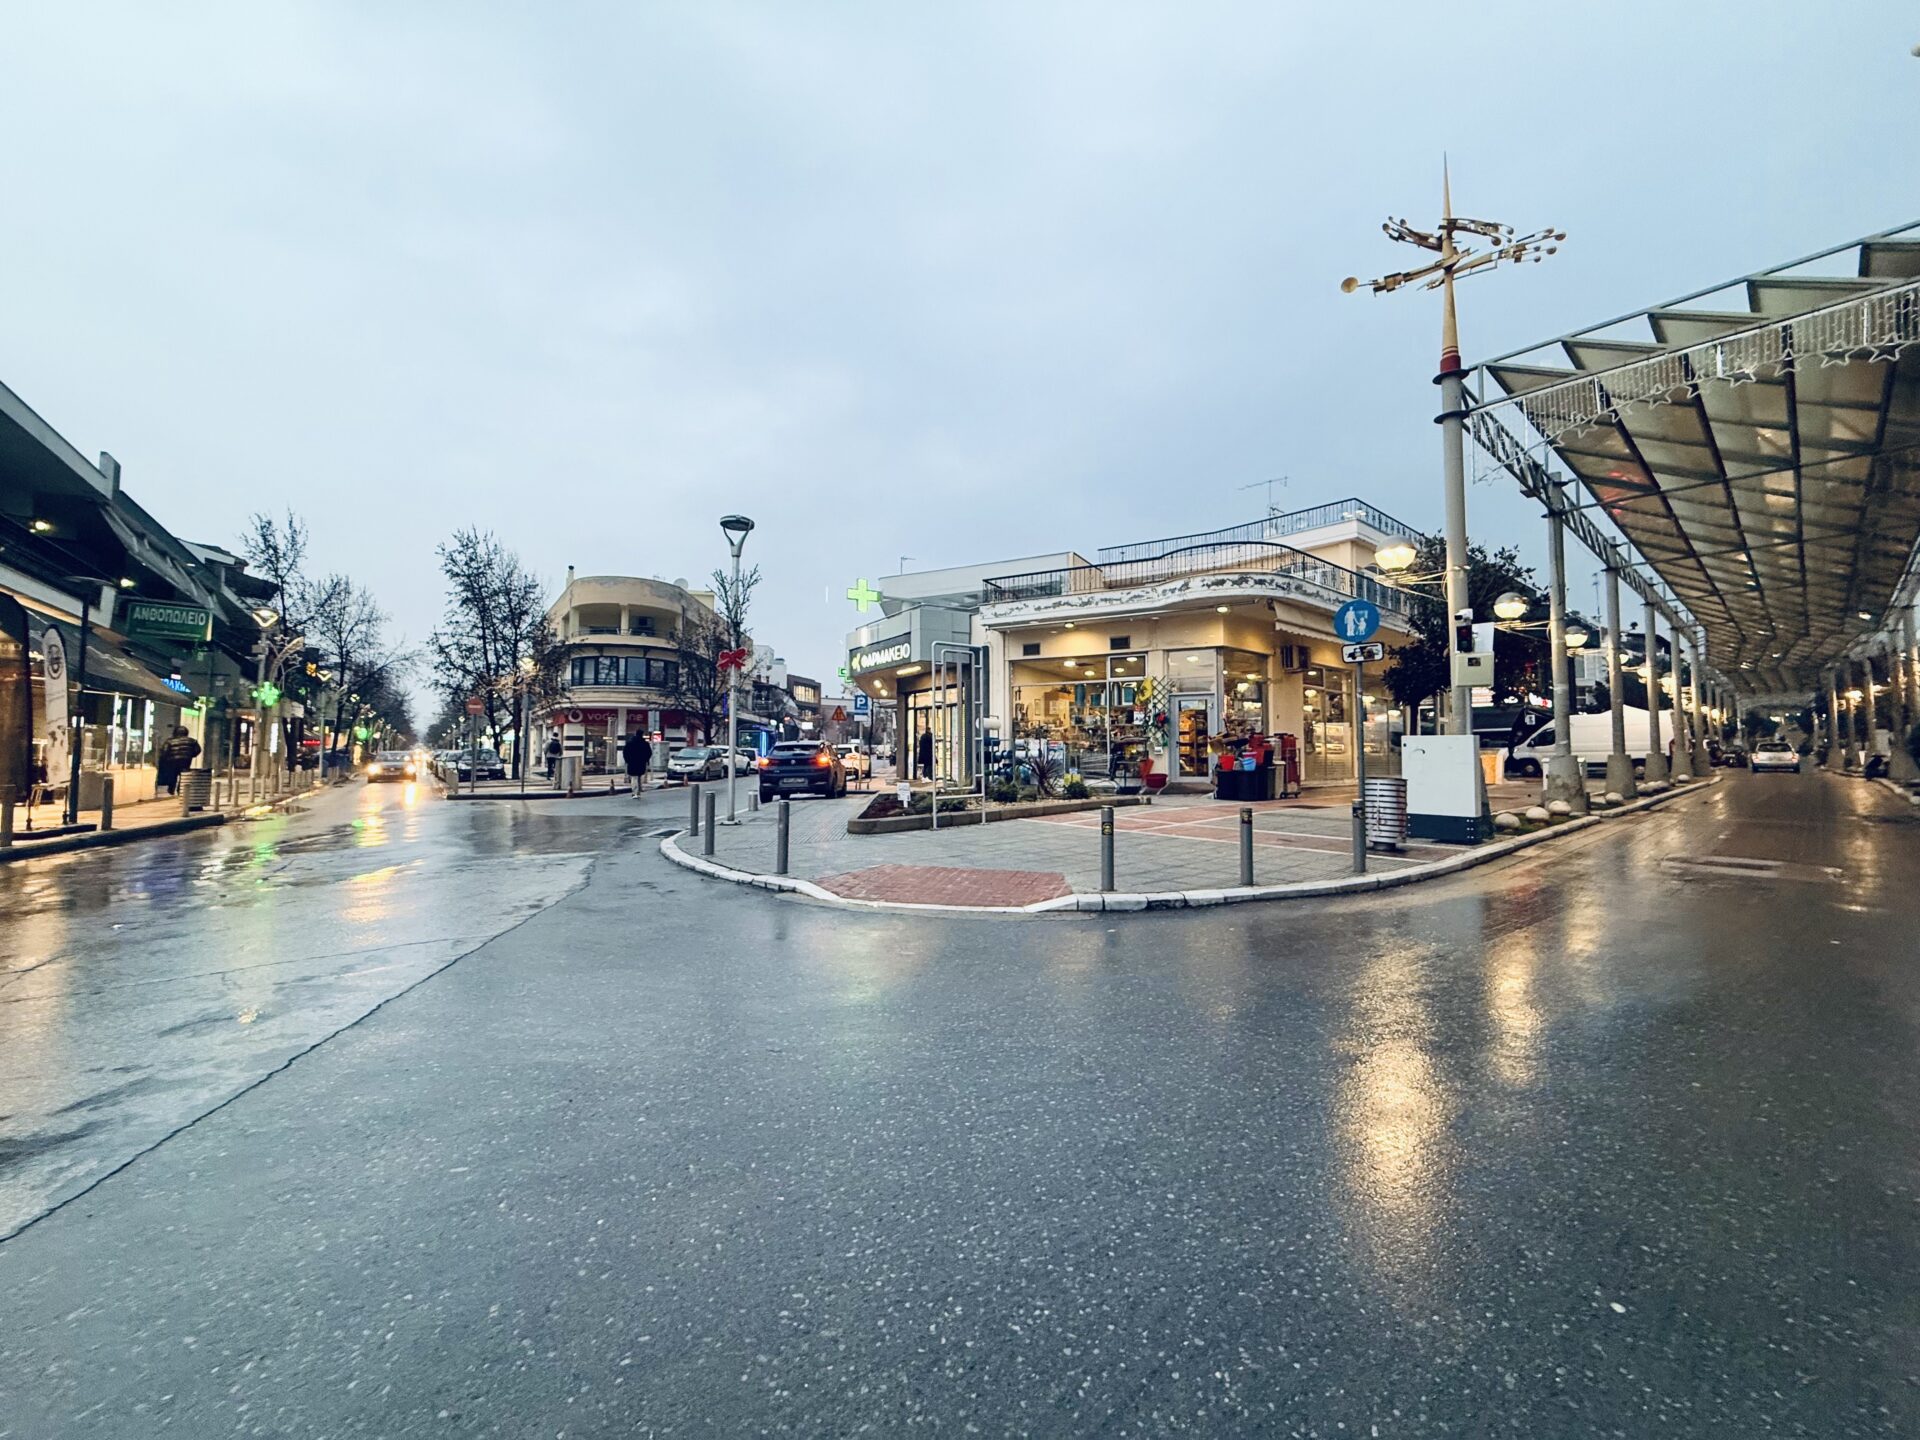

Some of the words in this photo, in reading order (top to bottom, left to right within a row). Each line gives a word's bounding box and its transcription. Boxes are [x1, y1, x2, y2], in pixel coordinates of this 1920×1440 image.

[133, 606, 206, 626] ΑΝΘΟΠΩΛΕΙΟ
[861, 643, 910, 668] ΦΑΡΜΑΚΕΙΟ
[857, 697, 866, 708] P
